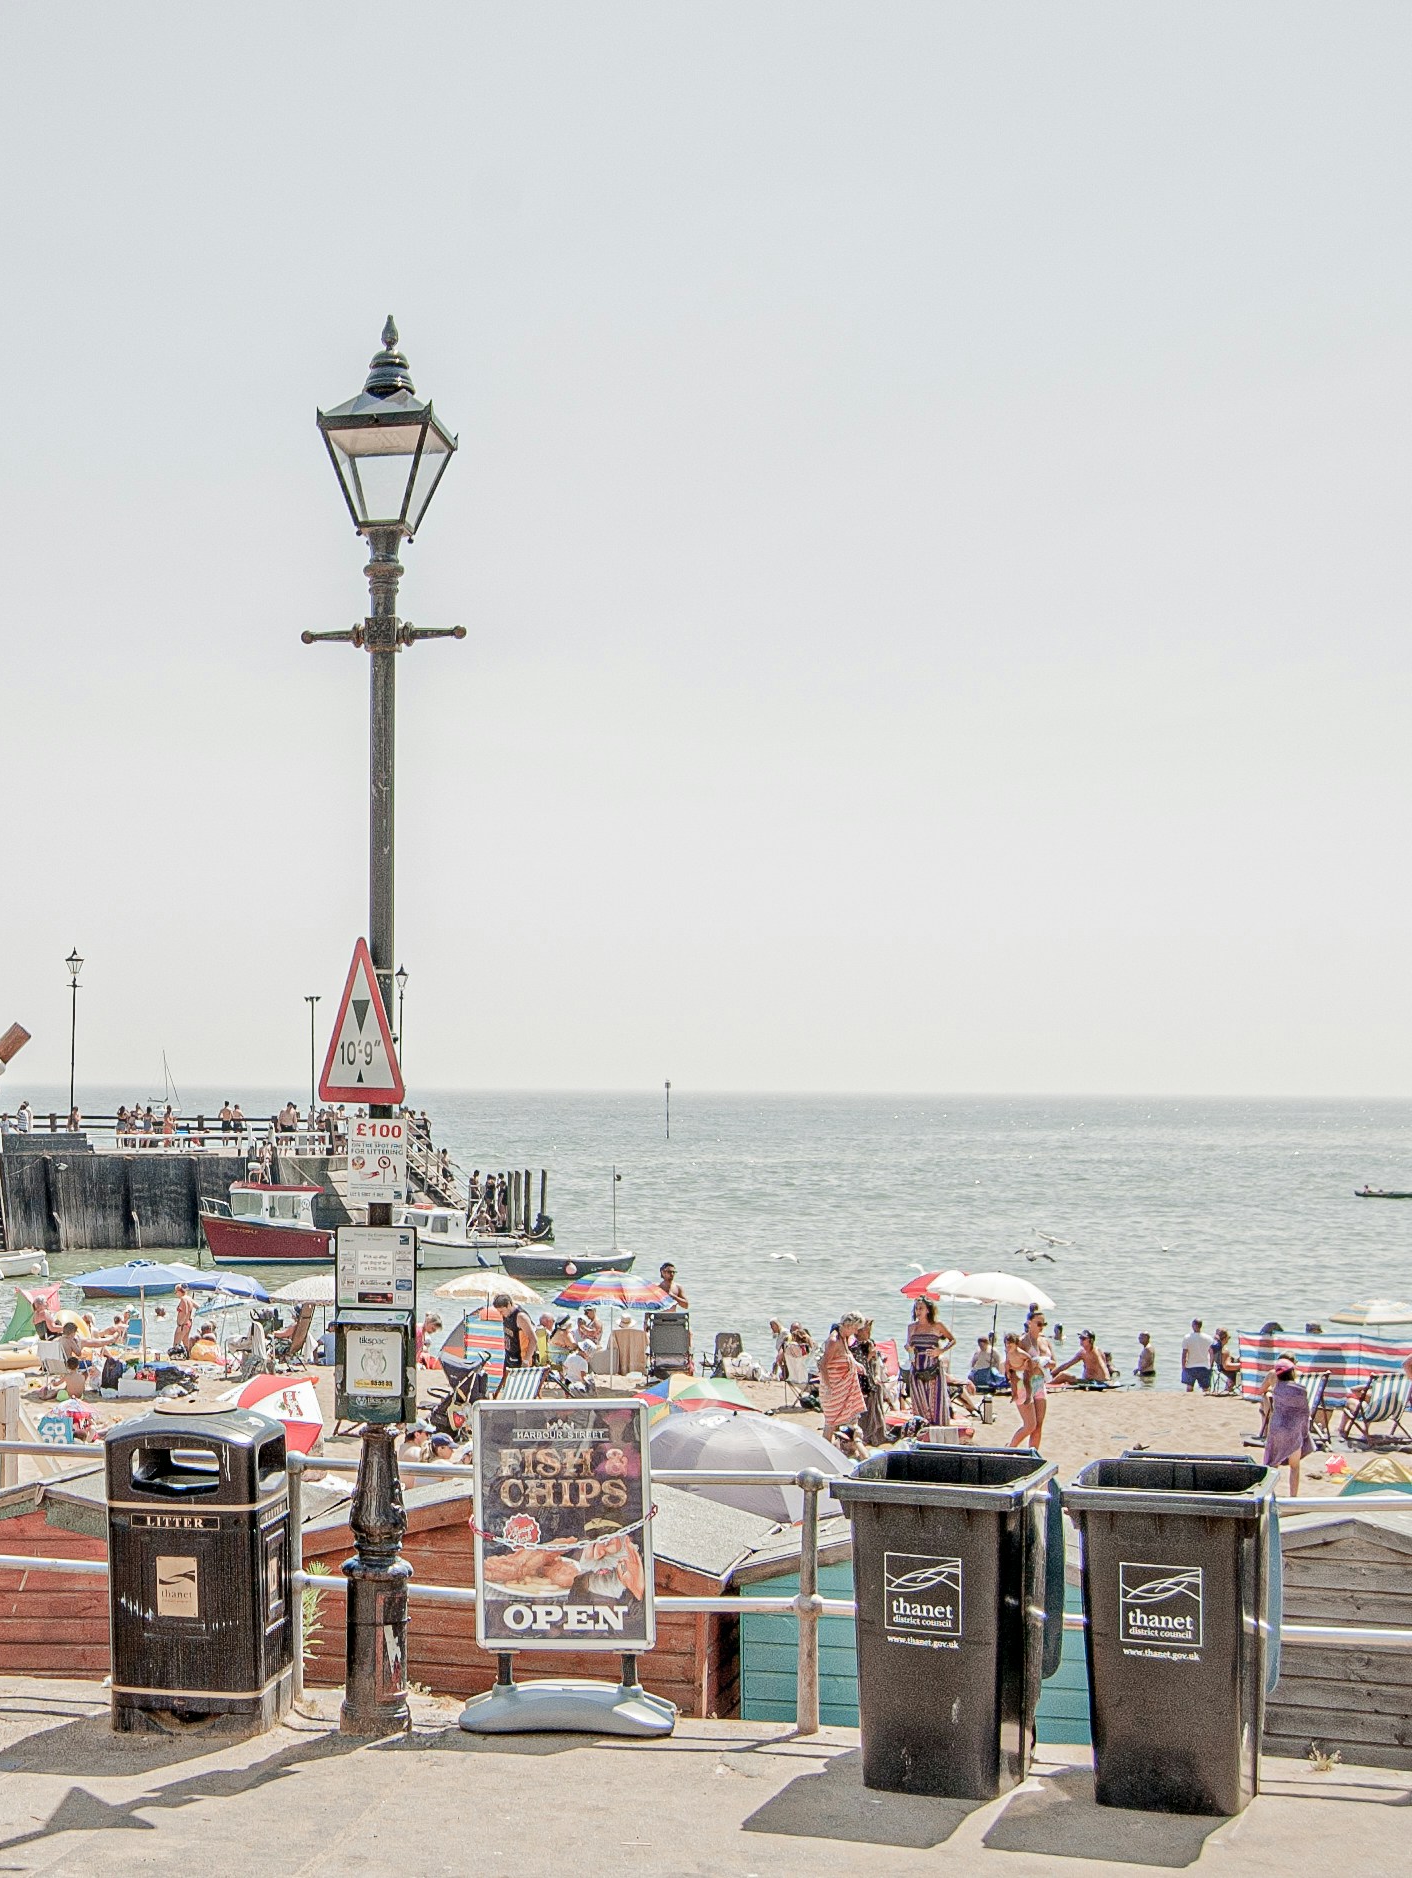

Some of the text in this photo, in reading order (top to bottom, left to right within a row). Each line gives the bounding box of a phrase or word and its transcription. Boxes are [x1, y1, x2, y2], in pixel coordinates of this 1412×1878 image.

[356, 1123, 402, 1138] £100
[366, 1148, 404, 1156] LITTERING
[516, 1430, 605, 1439] HARBOUR STREET
[498, 1448, 628, 1477] FISH &
[500, 1478, 628, 1508] CHIPS
[146, 1516, 204, 1528] LITTER
[161, 1589, 192, 1599] thanet
[891, 1597, 954, 1619] thanet
[503, 1604, 629, 1631] OPEN
[892, 1614, 952, 1628] district council
[1128, 1608, 1194, 1630] thanet
[1129, 1626, 1192, 1639] district council
[887, 1635, 960, 1649] www.thanet.gov.uk
[1122, 1647, 1201, 1662] www.thanet.gov.uk
